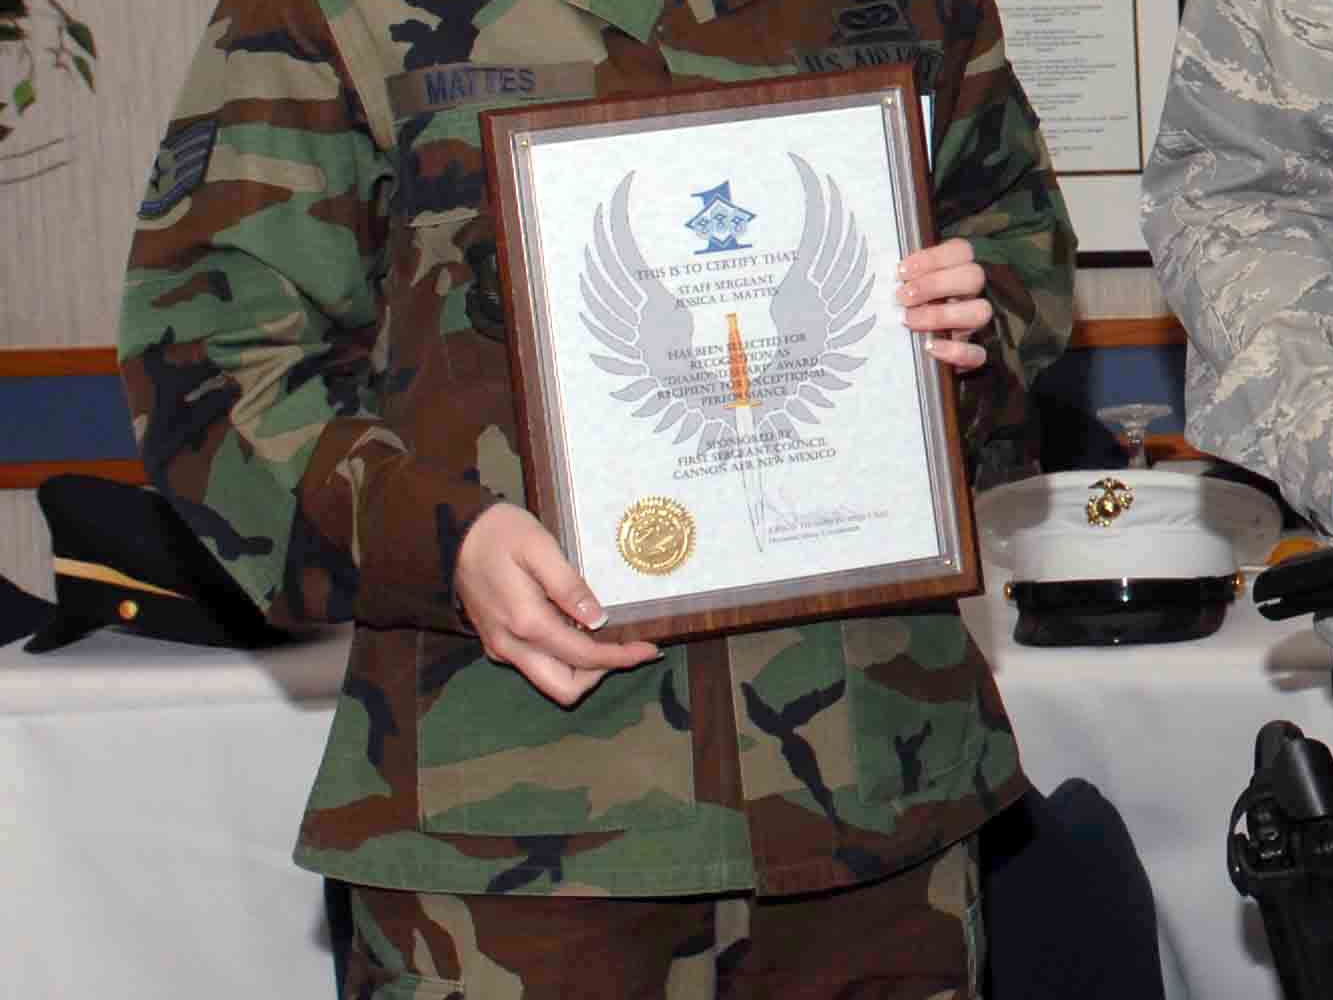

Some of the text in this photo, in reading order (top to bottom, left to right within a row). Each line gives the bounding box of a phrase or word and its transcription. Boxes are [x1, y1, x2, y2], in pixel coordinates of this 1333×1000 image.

[424, 67, 536, 103] MATTES
[635, 267, 666, 281] THIS
[683, 262, 703, 275] TO
[705, 254, 759, 272] CERTIFY
[761, 250, 800, 265] THAT
[788, 447, 837, 463] MEXICO
